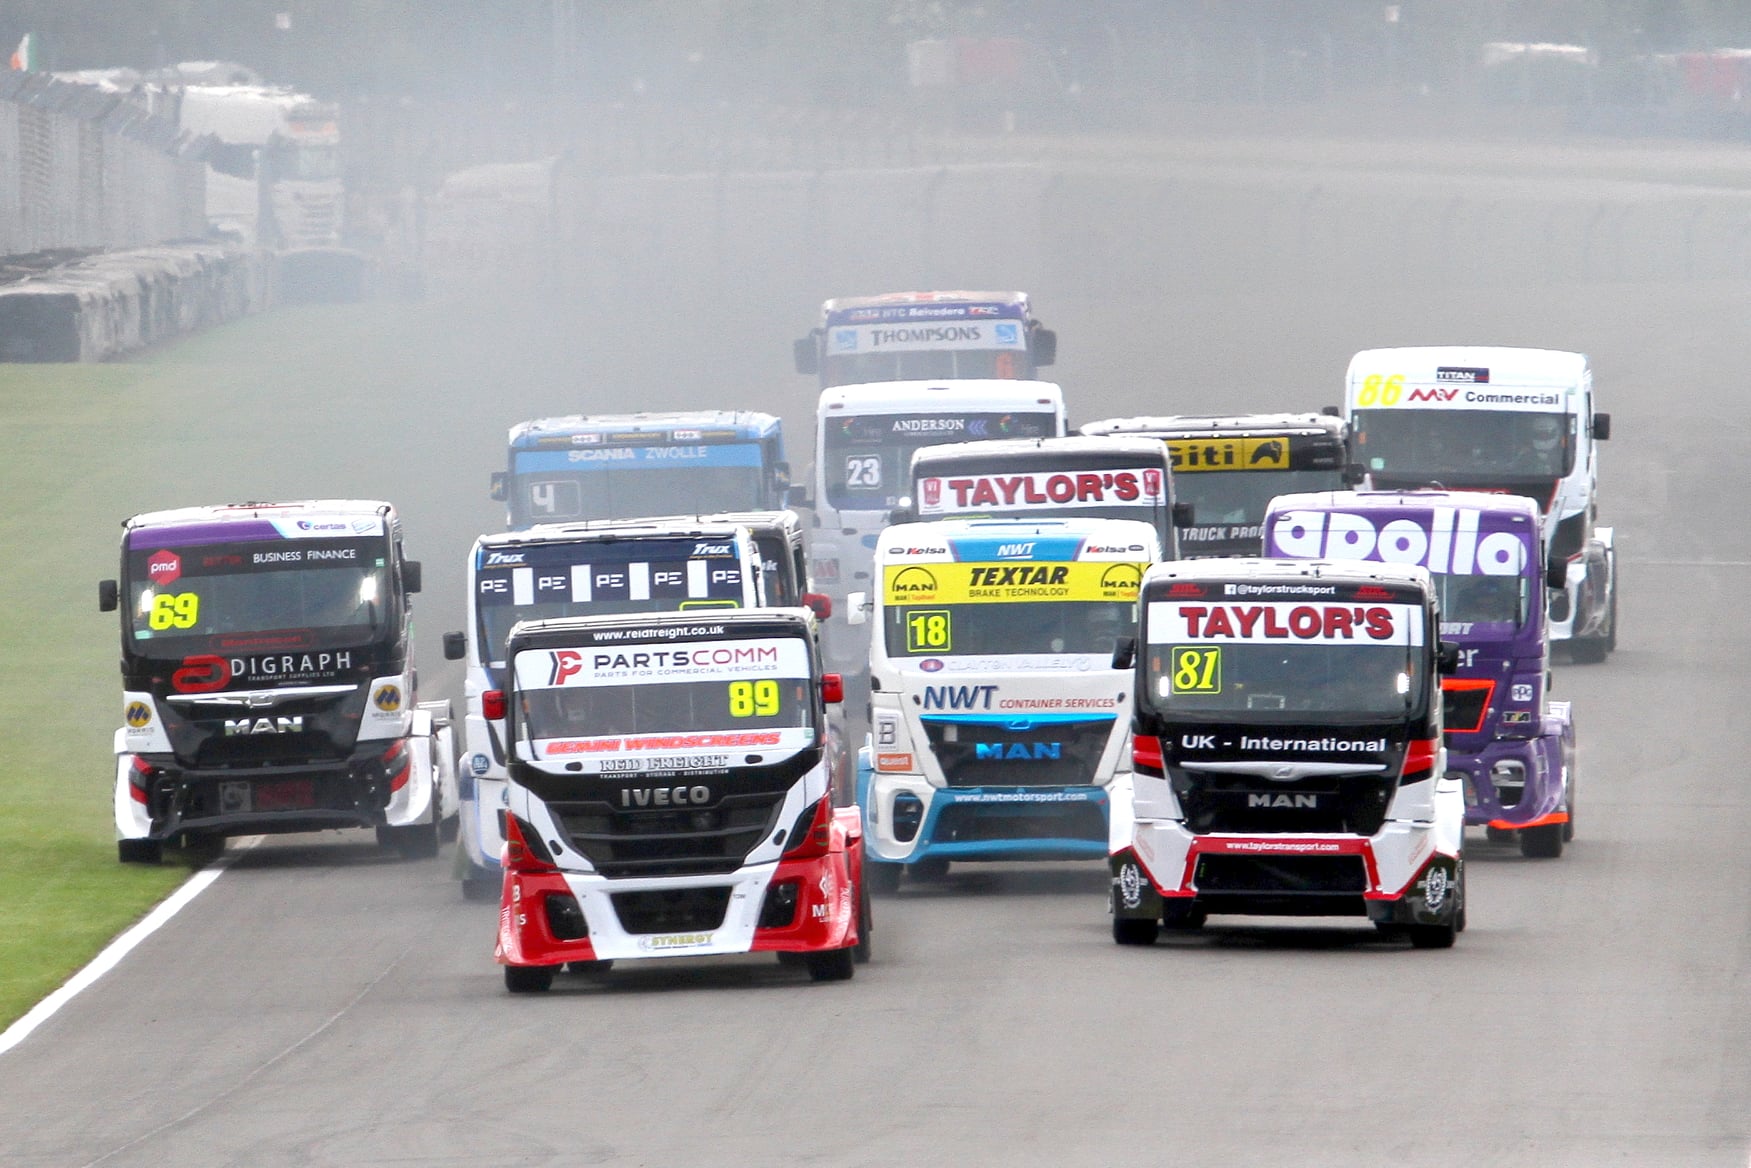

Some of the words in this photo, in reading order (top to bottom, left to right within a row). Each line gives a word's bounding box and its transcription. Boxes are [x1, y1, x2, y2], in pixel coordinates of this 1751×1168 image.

[871, 326, 981, 346] THOMPSONS
[1437, 371, 1475, 380] TITAN
[1357, 373, 1405, 407] 86
[1465, 391, 1559, 405] Commercial
[892, 418, 965, 432] ANDERSON
[568, 448, 636, 462] SCANIA
[645, 446, 708, 459] ZWOLLE
[848, 458, 880, 486] 23
[533, 484, 555, 512] 4
[948, 472, 1140, 507] TAYLOR'S
[1182, 527, 1226, 541] TRUCK
[1273, 506, 1528, 576] apollo
[253, 551, 301, 563] BUSINESS
[307, 549, 356, 561] FINANCE
[692, 543, 731, 555] Trux
[997, 542, 1037, 556] NWT
[151, 560, 177, 574] pmd
[487, 552, 525, 565] Trux
[969, 566, 1069, 587] TEXTAR
[895, 584, 933, 592] MAN
[969, 589, 1000, 597] BRAKE
[1005, 588, 1069, 597] TECHNOLOGY
[1238, 584, 1335, 596] @taylorstrucksport
[149, 592, 199, 630] 69
[911, 615, 946, 647] 18
[1179, 605, 1395, 640] TAYLOR'S
[593, 625, 724, 641] www.reidfreight.co.uk
[231, 651, 351, 676] DIGRAPH
[594, 646, 778, 670] PARTSCOMM
[657, 667, 722, 676] COMMERCIAL
[1174, 650, 1218, 690] 81
[729, 680, 779, 717] 89
[923, 685, 999, 709] NWT
[1000, 699, 1062, 709] CONTAINER
[1065, 698, 1115, 708] SERVICES
[225, 716, 303, 736] MAN
[546, 738, 622, 755] GEMINI
[624, 732, 782, 752] WINDSCREENS
[976, 742, 1062, 760] MAN
[1182, 735, 1214, 749] UK
[1241, 735, 1386, 752] International
[600, 758, 643, 772] REID
[648, 755, 729, 770] FREIGHT
[622, 785, 710, 807] IVECO
[954, 792, 1088, 802] www.nwtmotorsport.com
[1248, 794, 1317, 808] MAN
[1226, 842, 1340, 852] www.taylorstransport.com
[652, 933, 714, 946] SYNERGY
